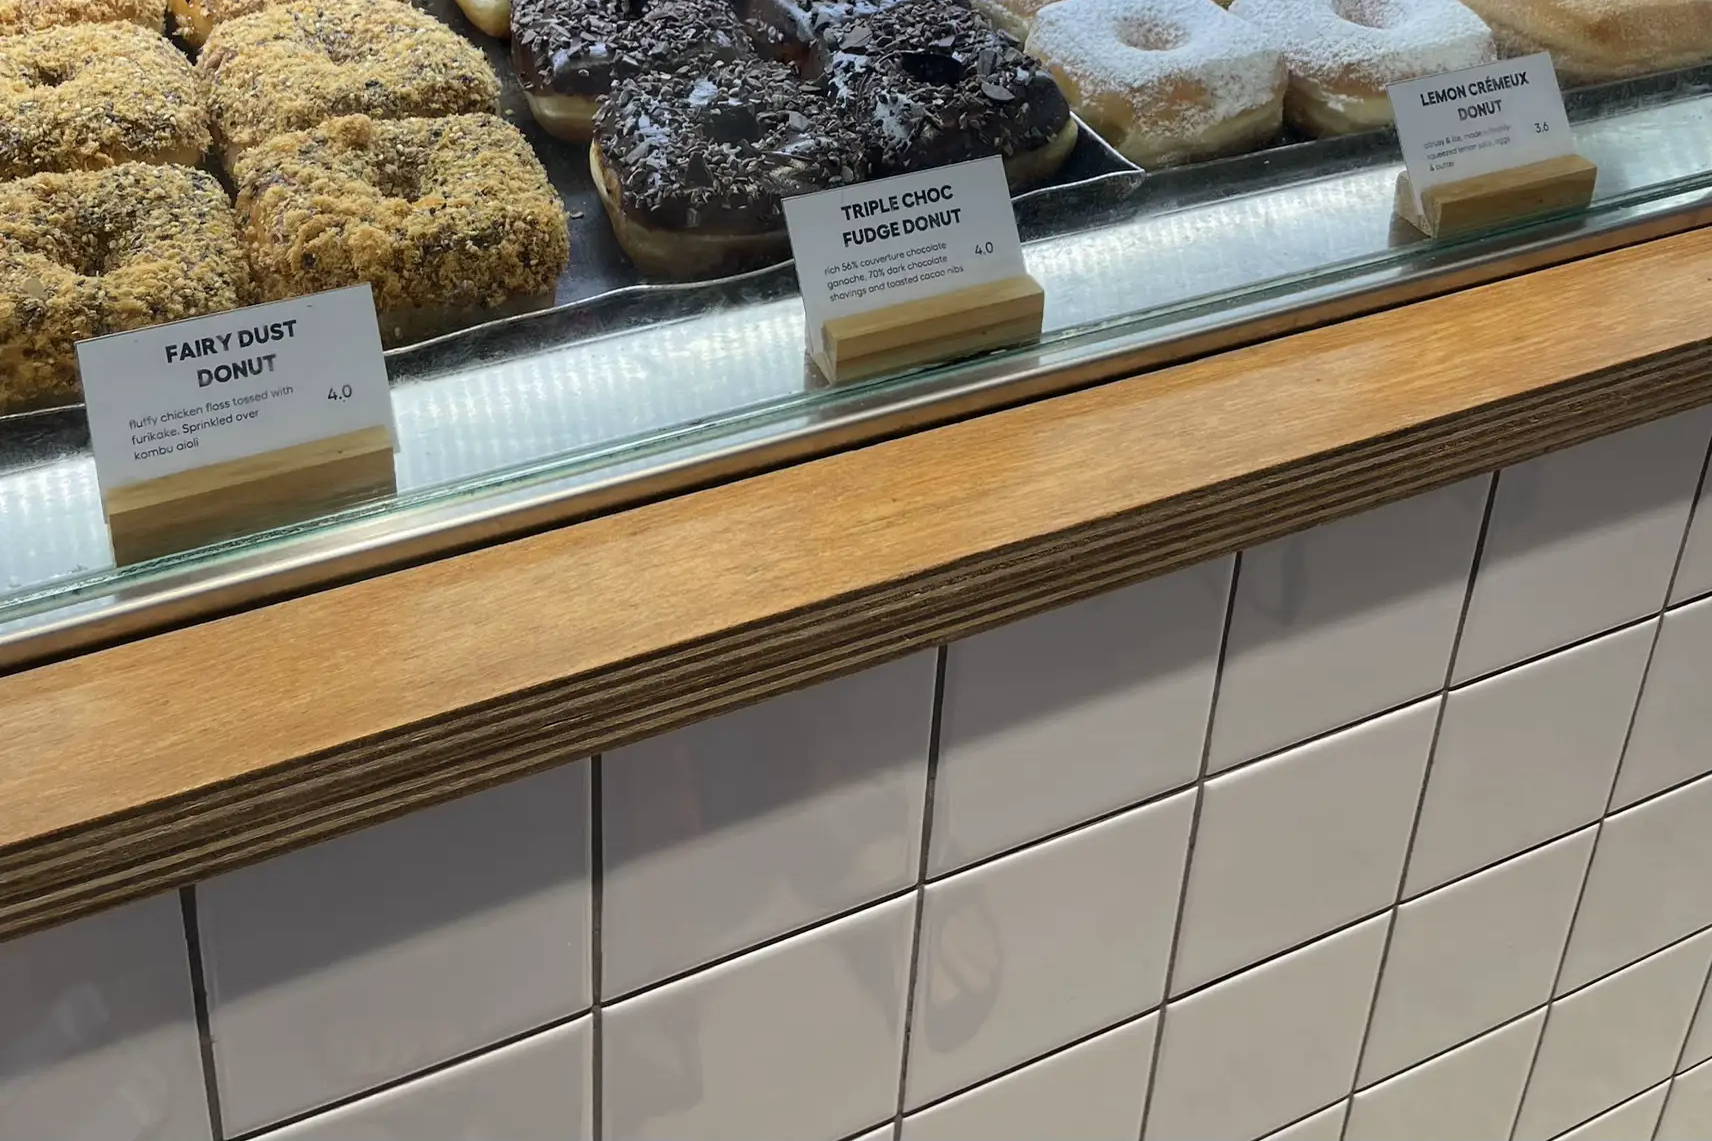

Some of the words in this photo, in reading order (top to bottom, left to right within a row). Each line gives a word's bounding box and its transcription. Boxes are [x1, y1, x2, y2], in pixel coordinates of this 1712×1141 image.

[1420, 84, 1467, 106] LEMON
[1458, 99, 1502, 121] DONUT
[1534, 121, 1549, 134] 3.6
[841, 196, 899, 221] TRIPLE
[902, 185, 954, 208] CHOC
[843, 221, 901, 248] FUDGE
[903, 208, 961, 235] DONUT
[824, 263, 841, 276] rich
[860, 251, 905, 268] couverture
[906, 242, 947, 257] chocolate
[974, 241, 994, 256] 4.0
[827, 271, 867, 290] ganache,
[868, 267, 886, 279] 70%
[886, 260, 906, 274] dark
[907, 254, 948, 271] chocolate
[829, 284, 867, 302] shavings
[869, 280, 886, 293] and
[887, 272, 919, 290] toasted
[920, 268, 946, 282] cacao
[947, 264, 964, 276] nibs
[165, 332, 233, 363] FAIRY
[238, 319, 297, 348] DUST
[197, 353, 277, 387] DONUT
[129, 415, 158, 430] fluffy
[160, 407, 204, 423] chicken
[205, 400, 230, 414] floss
[232, 390, 268, 407] tossed
[270, 385, 294, 398] with
[327, 384, 353, 401] 4.0
[132, 427, 181, 445] furikake.
[182, 414, 233, 435] Sprinkled
[235, 409, 260, 422] over
[133, 443, 174, 461] kombu
[176, 438, 200, 452] aioli
